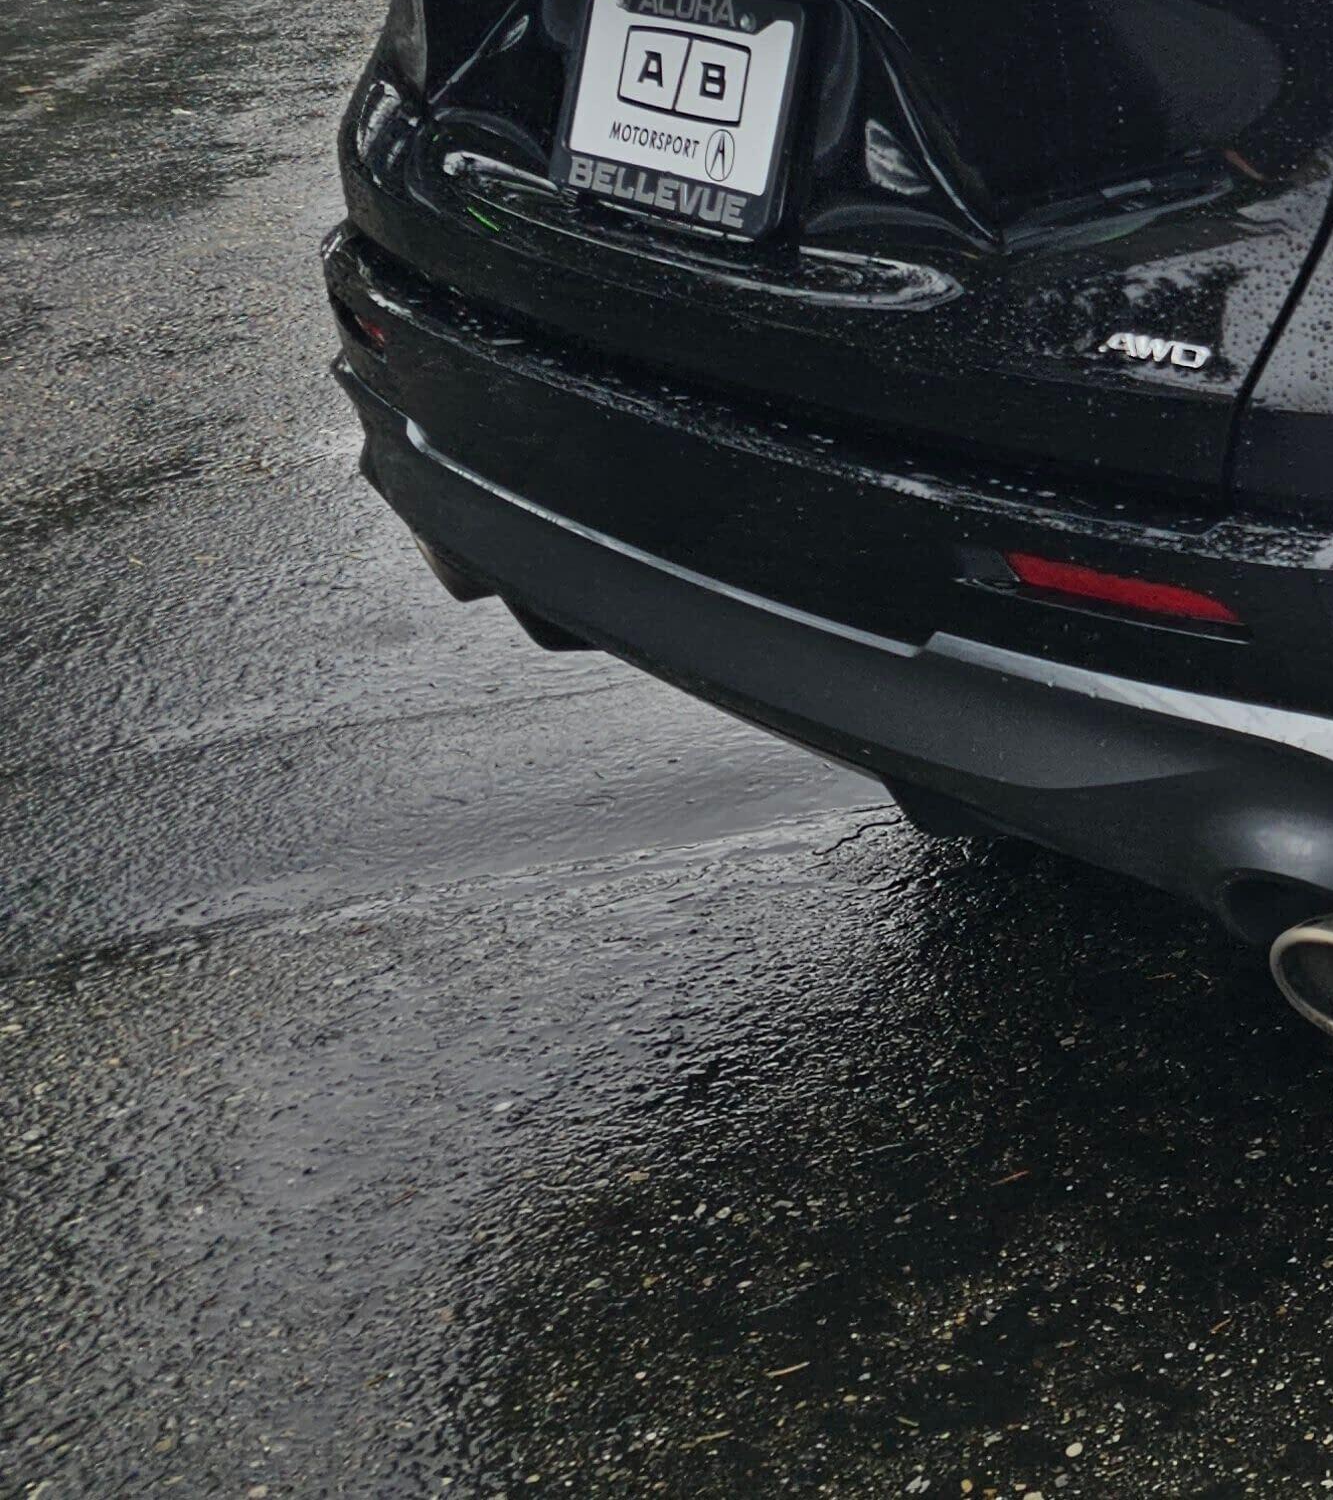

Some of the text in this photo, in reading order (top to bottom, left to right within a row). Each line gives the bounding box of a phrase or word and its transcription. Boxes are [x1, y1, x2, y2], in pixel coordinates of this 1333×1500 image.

[609, 121, 700, 159] MOTORSPORT
[568, 155, 747, 229] BELLEVUE
[1098, 332, 1212, 369] AWD
